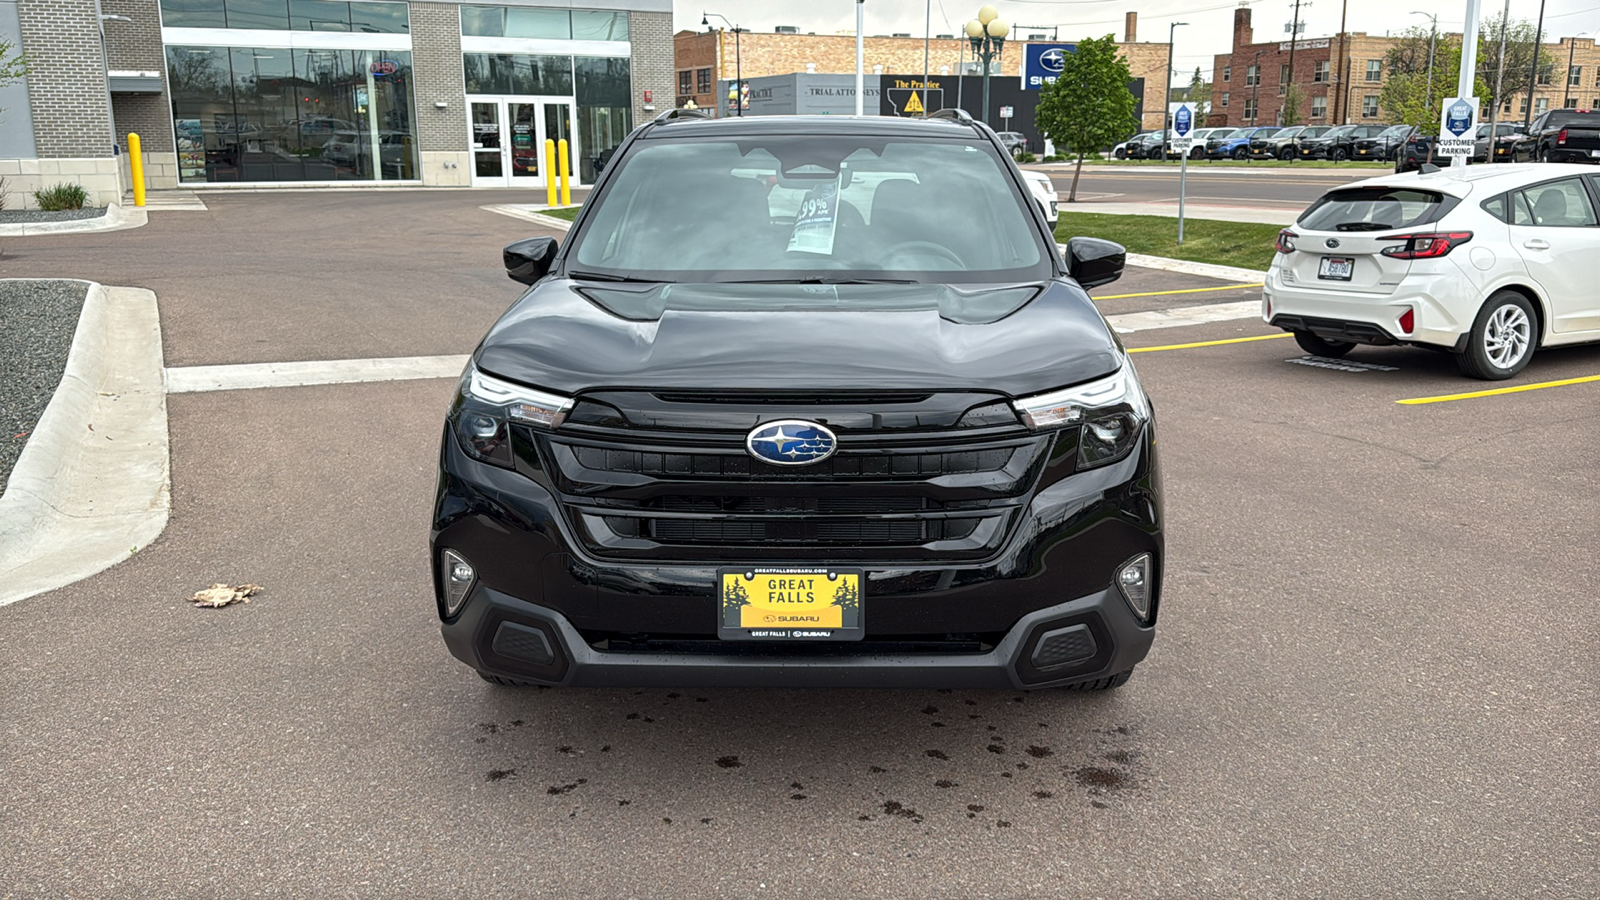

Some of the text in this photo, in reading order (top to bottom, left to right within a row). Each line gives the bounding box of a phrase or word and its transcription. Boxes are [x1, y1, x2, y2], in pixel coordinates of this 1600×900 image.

[370, 62, 395, 73] OPEN
[894, 80, 940, 88] The Pratice
[810, 88, 880, 96] TRIAL ATTONEYS
[1441, 147, 1471, 155] PARKING
[768, 579, 815, 590] GREAT
[768, 591, 815, 603] FALLS
